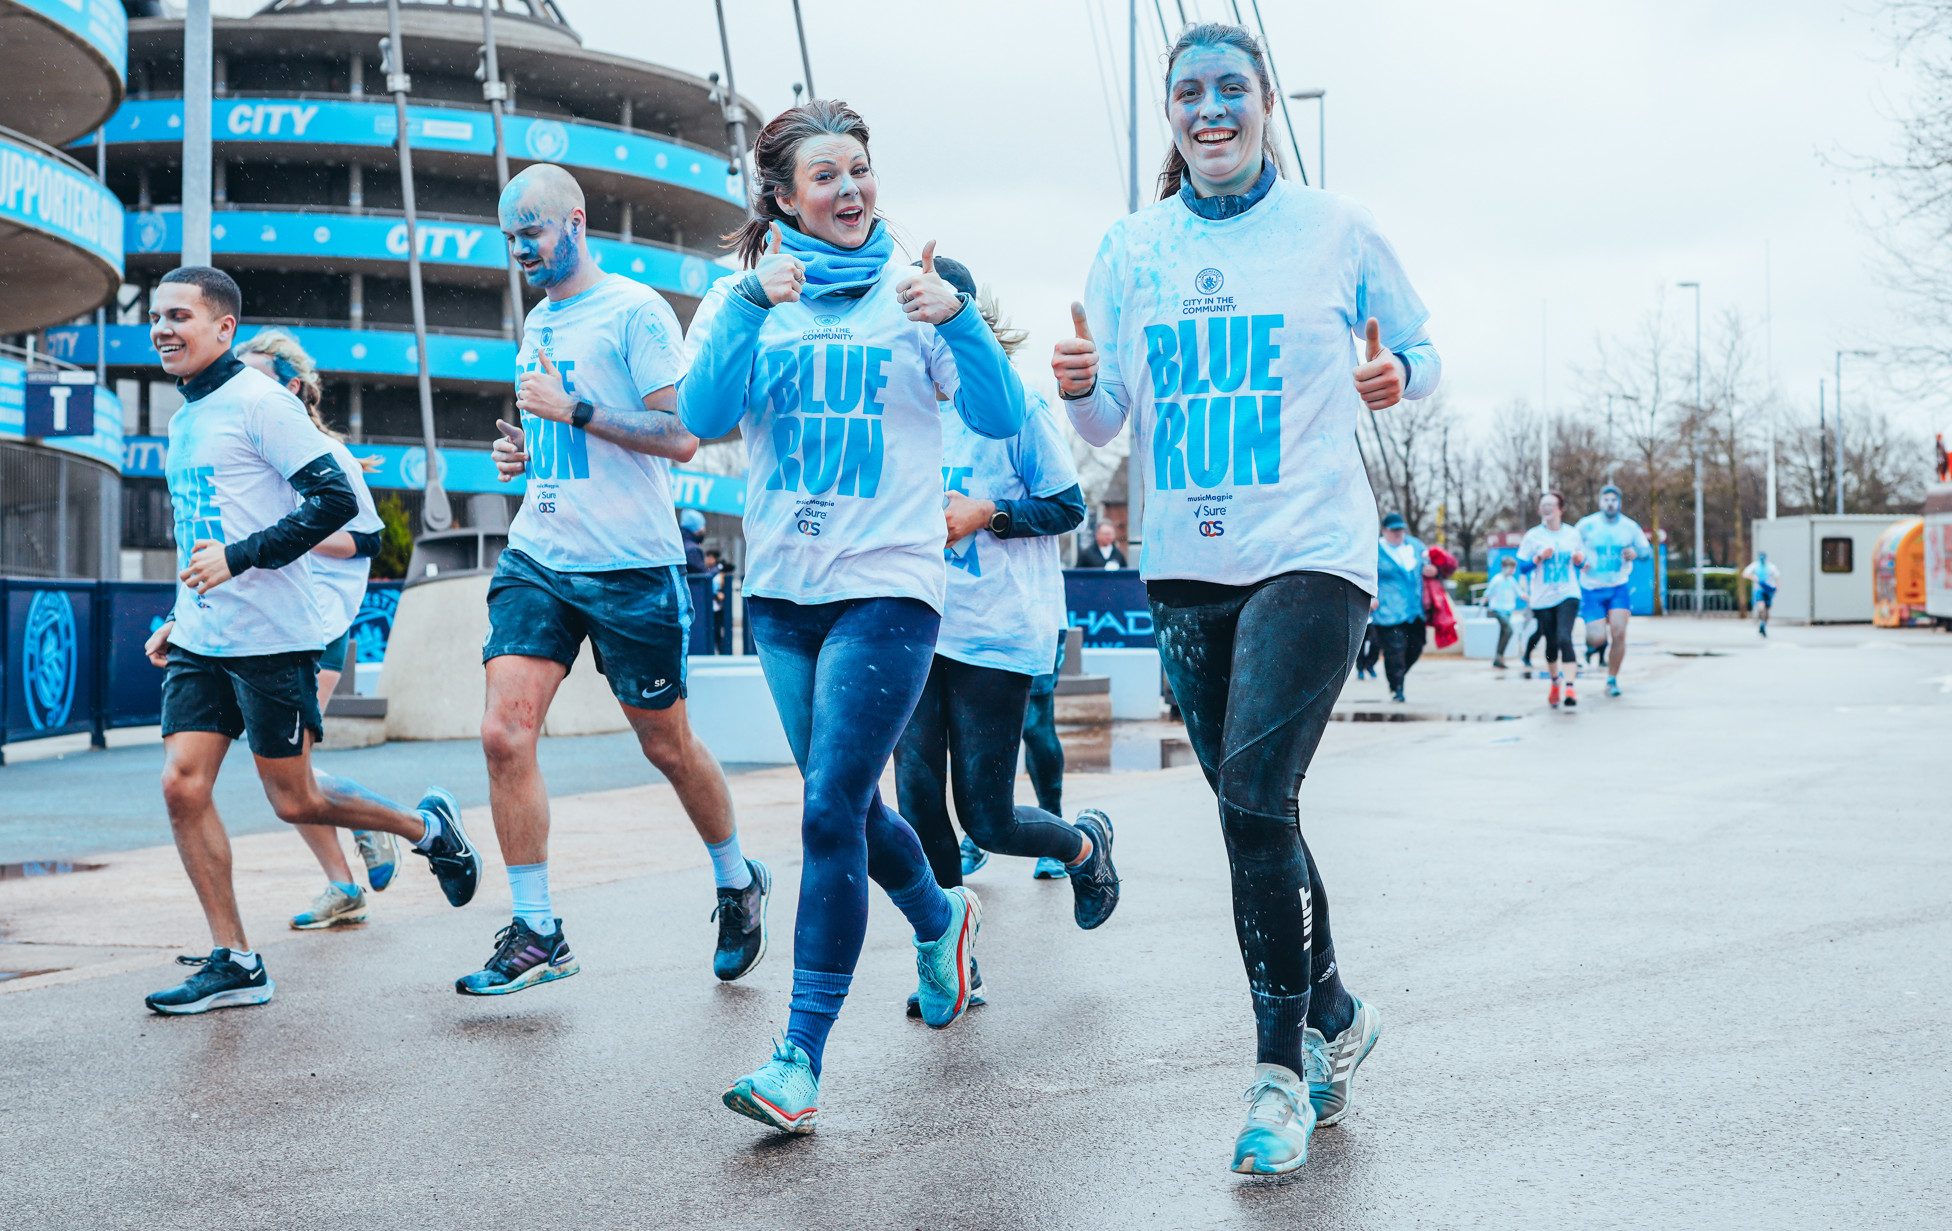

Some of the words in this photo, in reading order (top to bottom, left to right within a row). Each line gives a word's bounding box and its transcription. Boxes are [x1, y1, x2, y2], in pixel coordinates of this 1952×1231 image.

[227, 104, 319, 136] CITY
[386, 224, 483, 259] CITY
[1182, 298, 1203, 307] CITY
[1204, 297, 1214, 305] IN
[1216, 296, 1234, 304] THE
[1182, 304, 1237, 315] COMMUNITY
[802, 333, 854, 341] COMMUNITY
[1144, 313, 1285, 399] BLUE
[764, 343, 893, 416] BLUE
[49, 386, 72, 431] T
[1153, 394, 1283, 491] RUN
[765, 415, 885, 499] RUN
[1187, 492, 1233, 503] musicMagpie
[804, 507, 828, 520] Sure
[1203, 505, 1227, 517] Sure
[654, 678, 666, 688] SP
